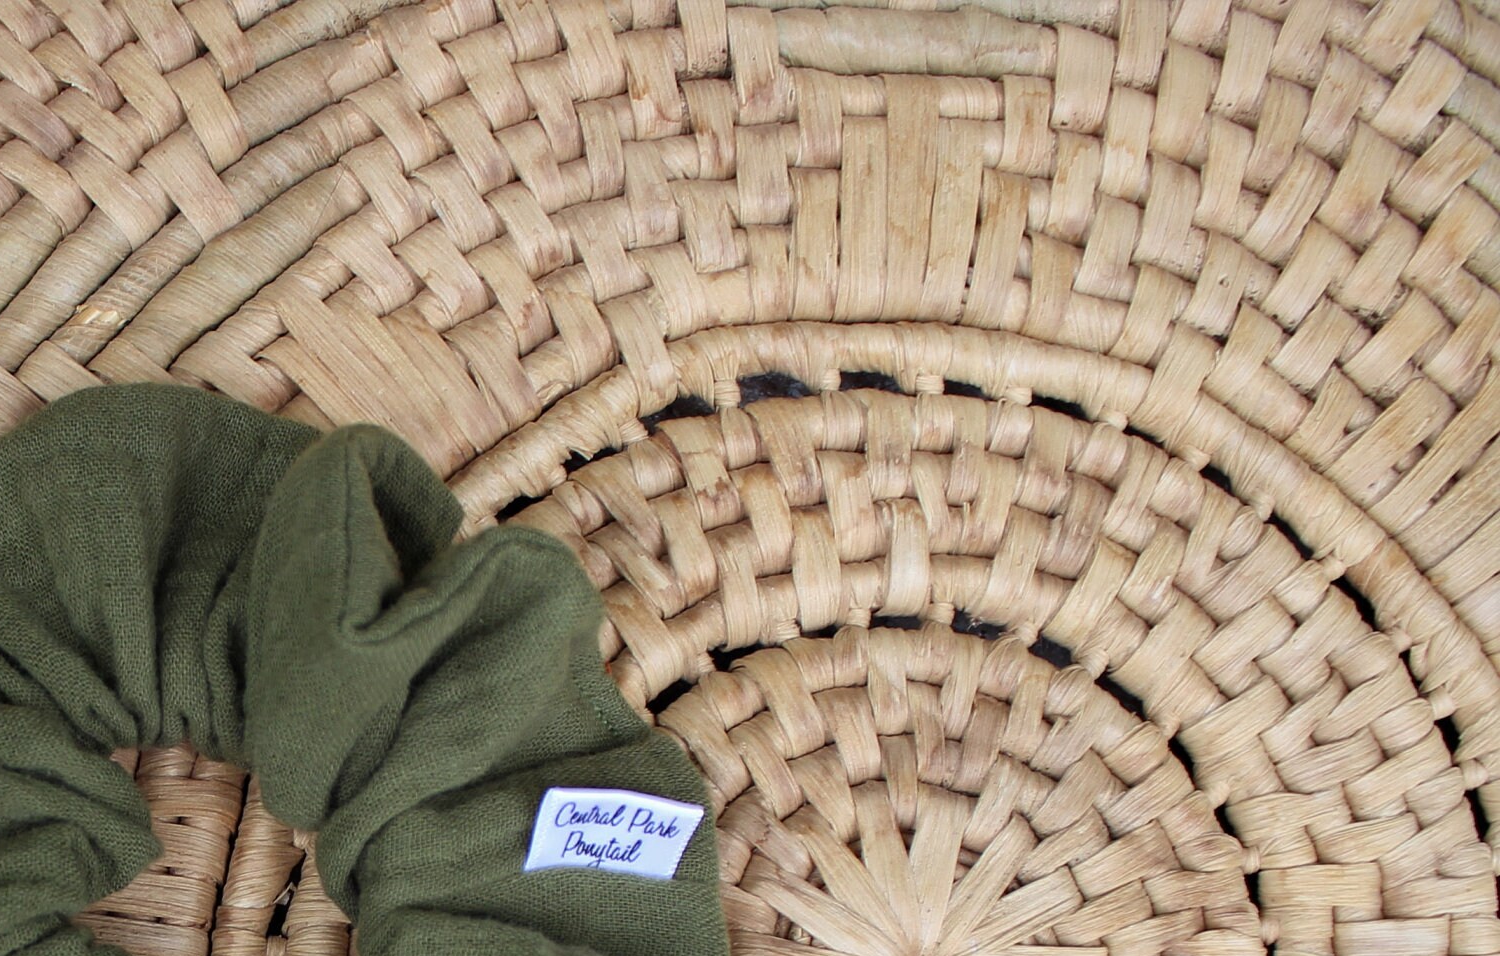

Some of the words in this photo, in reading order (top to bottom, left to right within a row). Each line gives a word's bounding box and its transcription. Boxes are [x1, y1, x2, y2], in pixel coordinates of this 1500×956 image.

[554, 801, 627, 828] Central
[627, 807, 680, 838] Park
[561, 830, 643, 868] Ponytail
